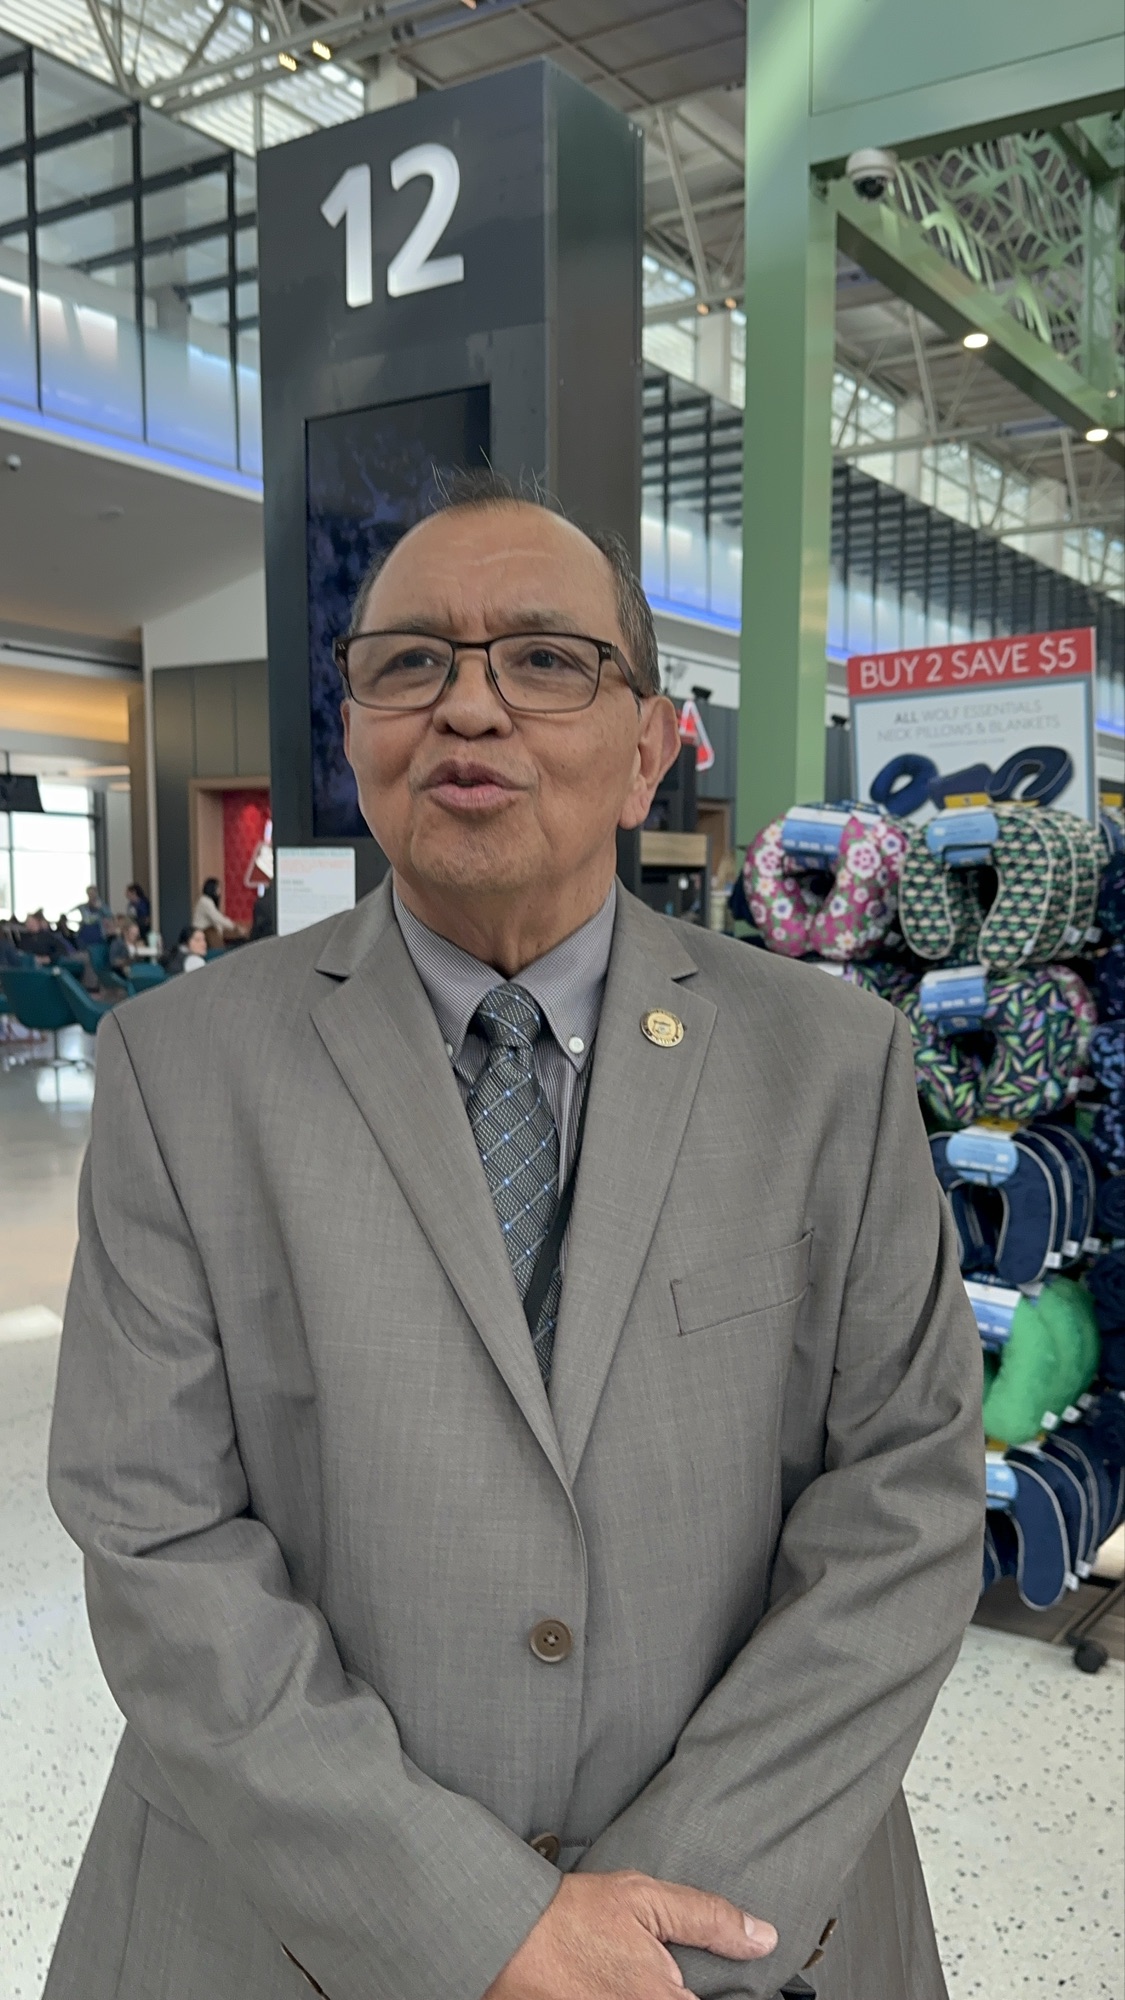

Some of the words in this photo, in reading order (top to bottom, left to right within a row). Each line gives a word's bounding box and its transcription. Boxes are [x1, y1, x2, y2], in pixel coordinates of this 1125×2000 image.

[320, 142, 464, 308] 12
[860, 655, 920, 690] BUY
[925, 653, 943, 683] 2
[951, 642, 1030, 680] SAVE
[1038, 636, 1077, 673] $5
[877, 727, 912, 742] NECK
[915, 722, 974, 739] PILLOWS
[976, 721, 986, 735] &
[989, 714, 1061, 734] BLANKETS
[894, 711, 919, 724] ALL
[921, 706, 960, 722] WOLF
[963, 699, 1043, 719] ESSENTIALS
